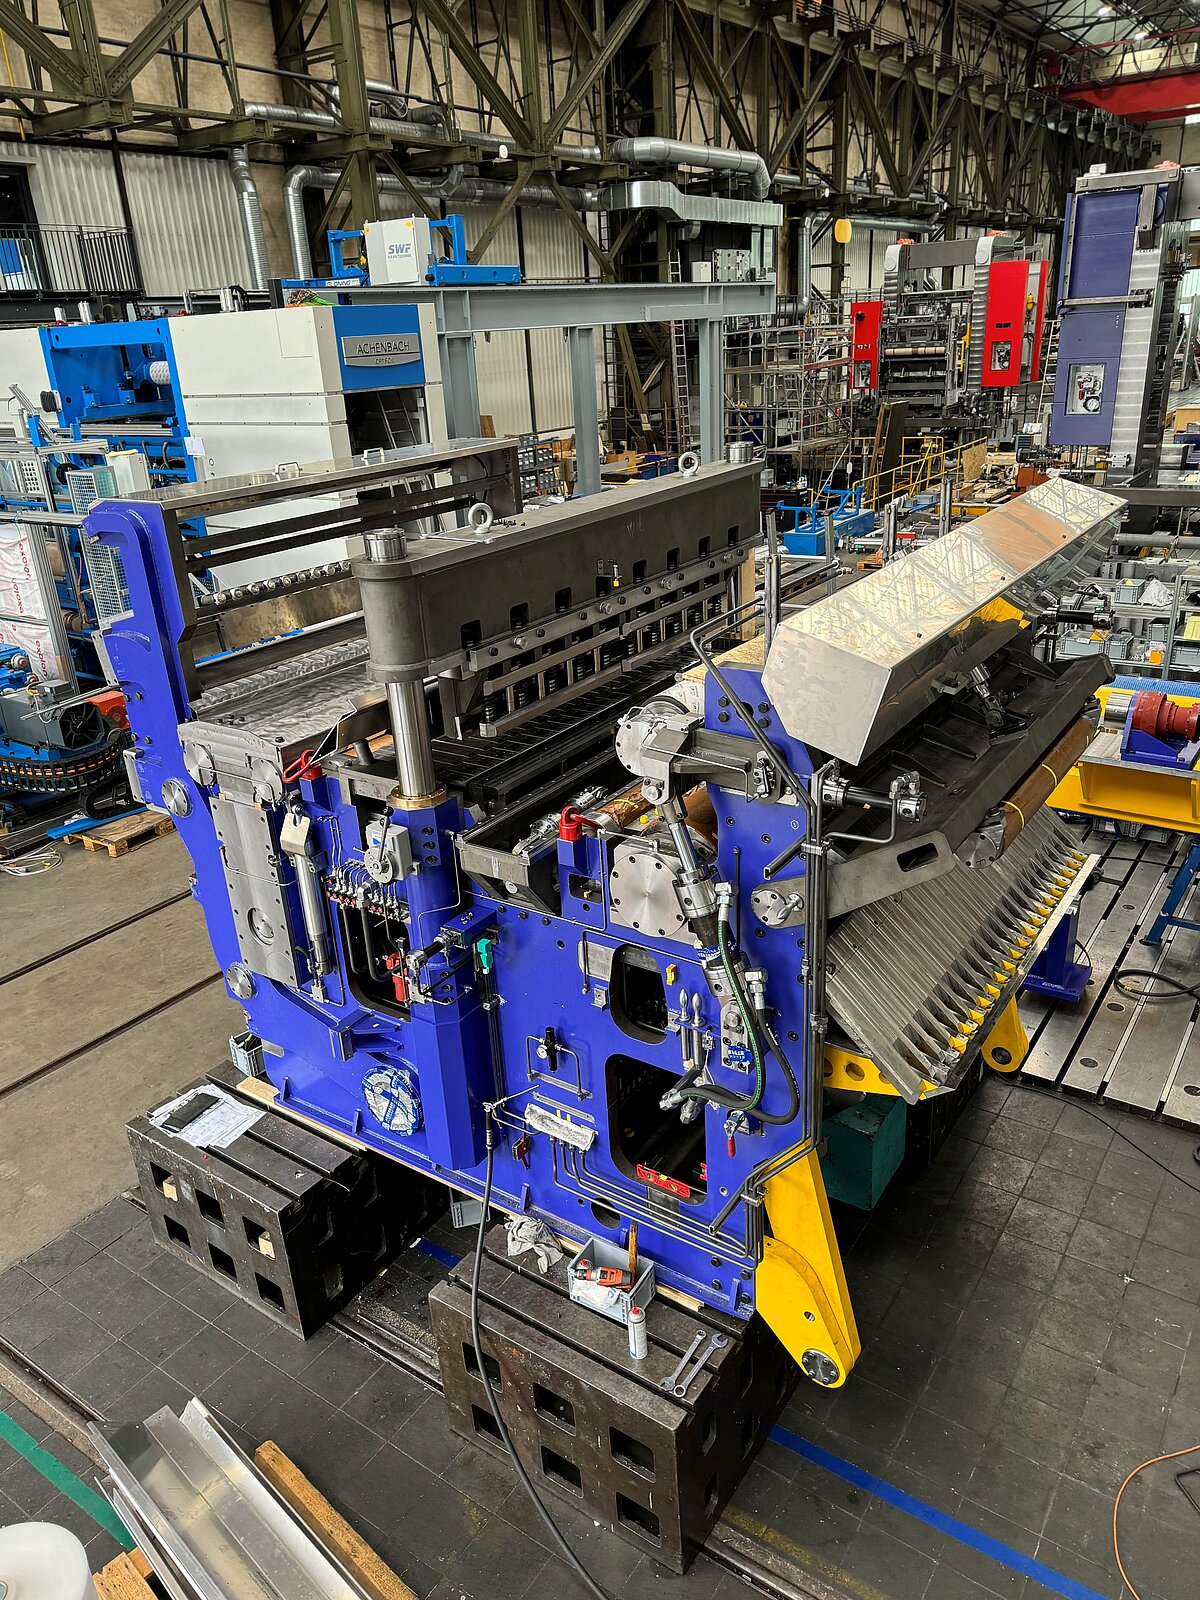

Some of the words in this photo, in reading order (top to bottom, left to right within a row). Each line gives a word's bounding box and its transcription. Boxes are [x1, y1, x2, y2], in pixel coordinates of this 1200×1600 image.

[388, 243, 411, 255] SWF
[357, 341, 410, 354] ACHENBACH
[18, 542, 31, 581] exolon
[35, 639, 48, 677] exolon
